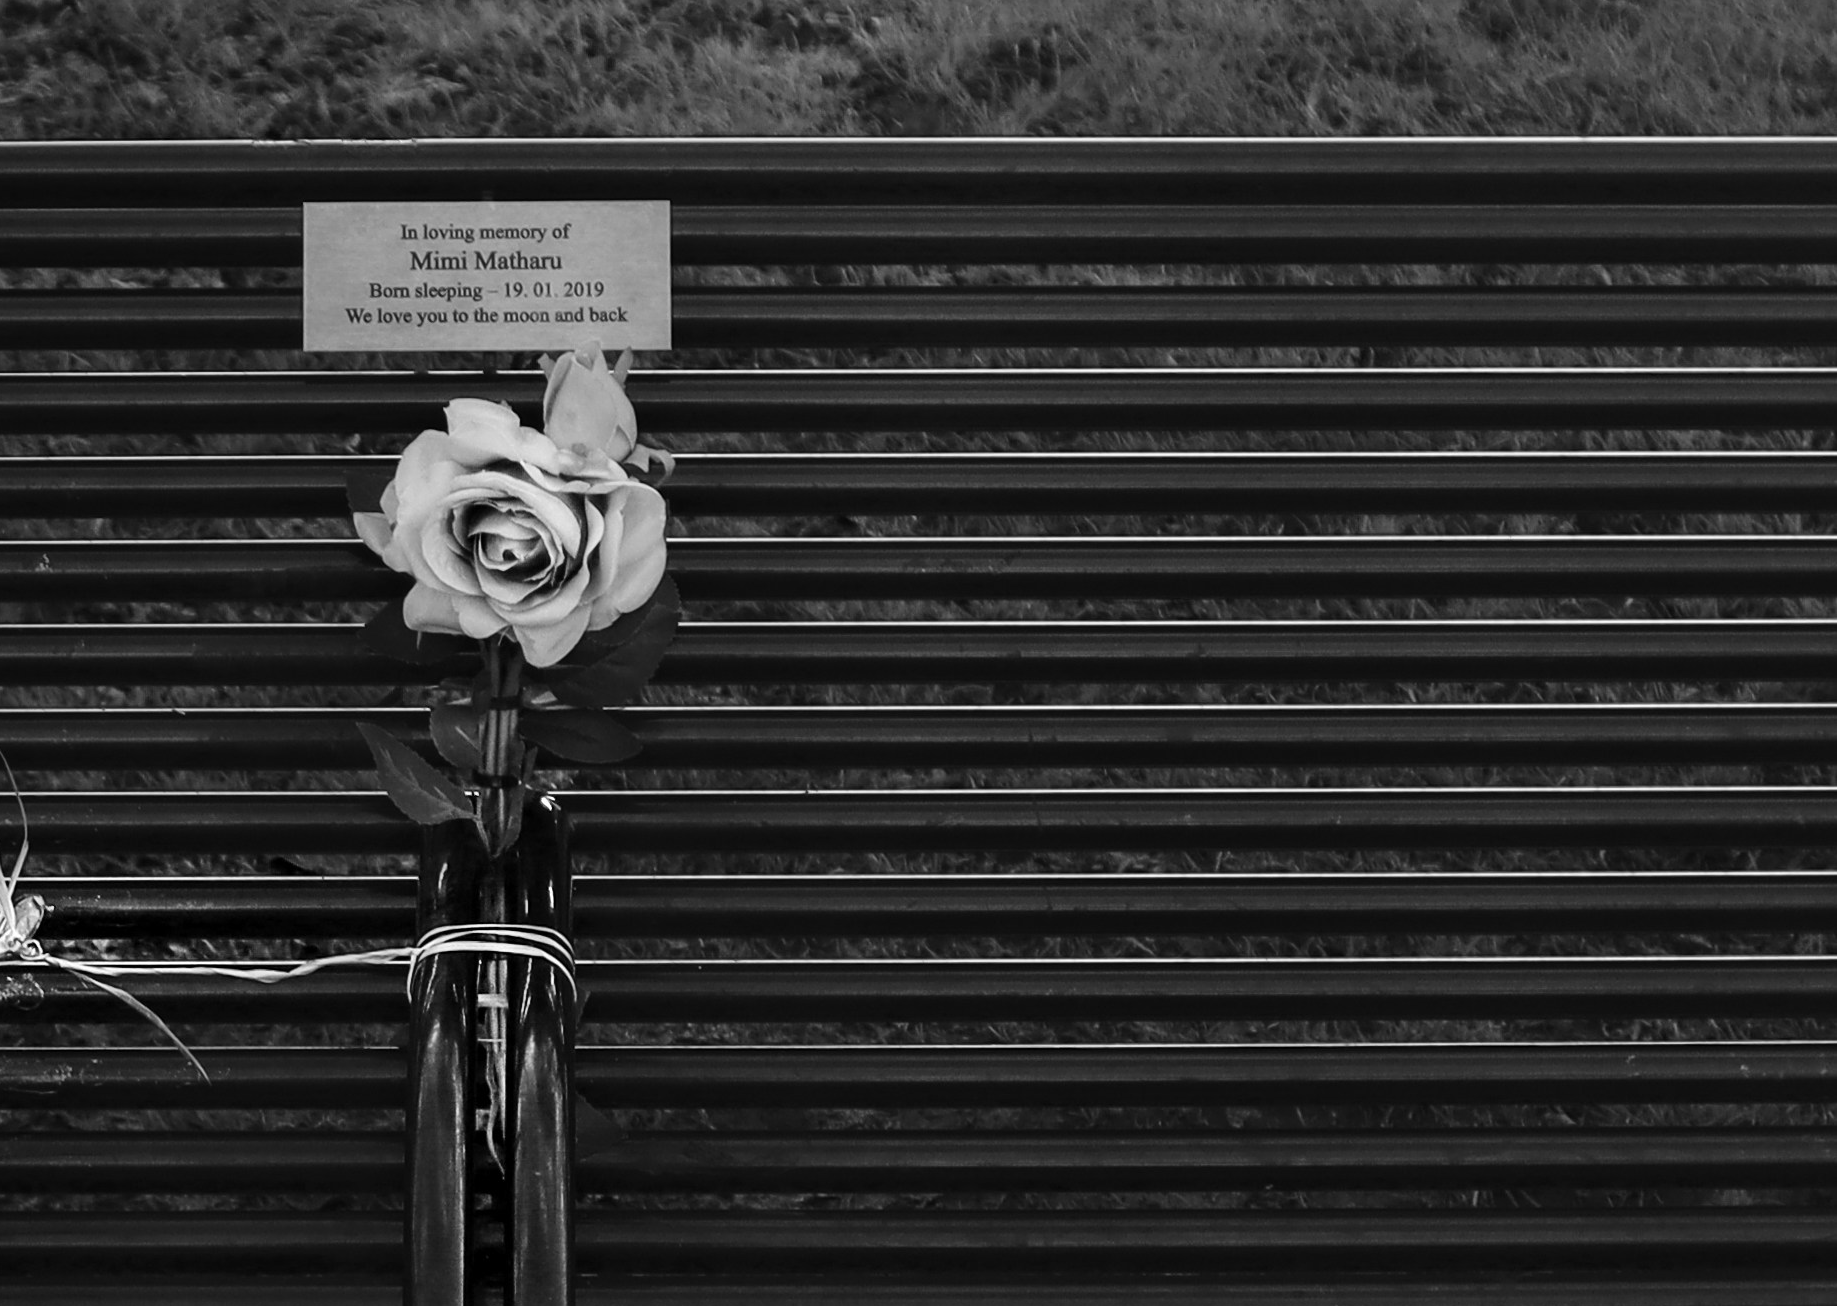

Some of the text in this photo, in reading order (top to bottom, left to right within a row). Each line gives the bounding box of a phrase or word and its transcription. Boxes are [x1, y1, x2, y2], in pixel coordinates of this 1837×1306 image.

[400, 223, 572, 244] In loving memory of
[410, 250, 563, 271] Mimi Matharu
[368, 282, 411, 298] Born
[415, 282, 483, 302] sleeping
[563, 281, 605, 298] 2019
[344, 306, 628, 327] We love you to the moon and back
